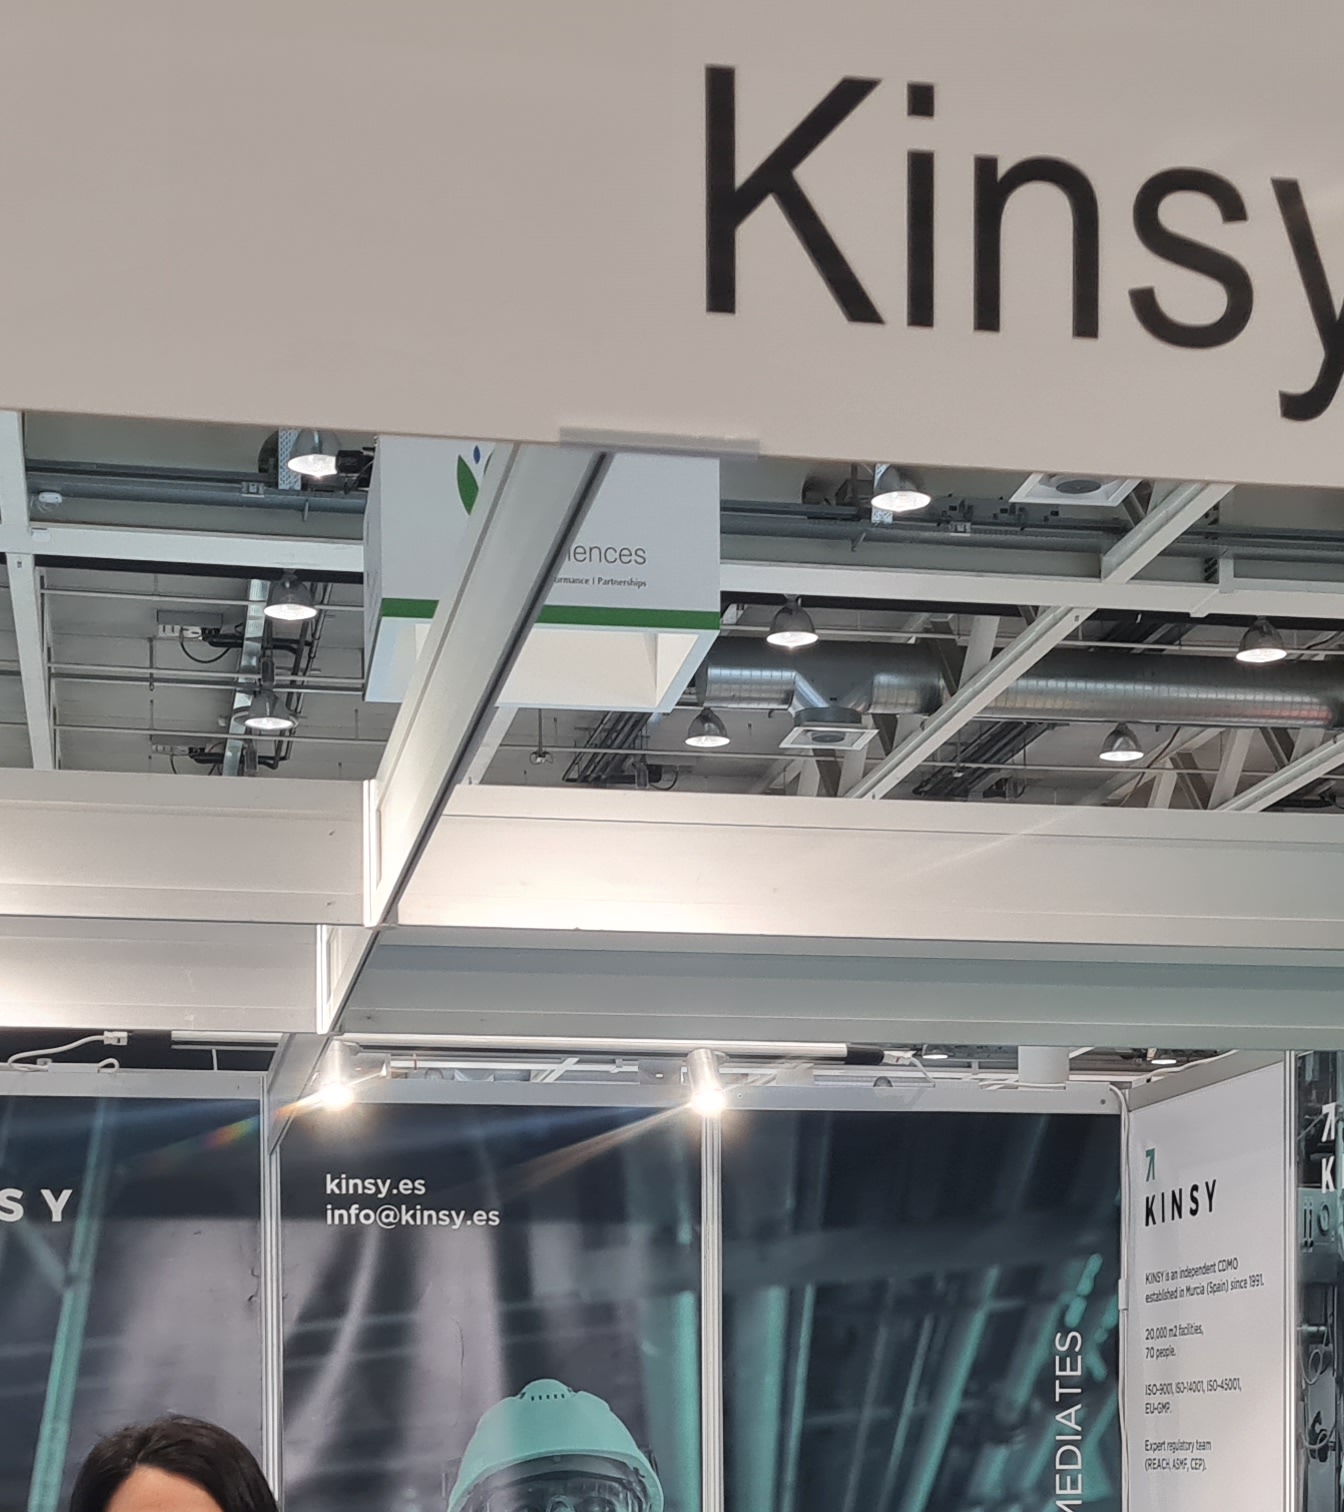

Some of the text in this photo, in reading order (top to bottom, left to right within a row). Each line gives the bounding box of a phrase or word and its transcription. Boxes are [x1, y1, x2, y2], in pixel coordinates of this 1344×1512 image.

[597, 576, 647, 589] Partnerships
[325, 1173, 426, 1198] kinsy.es
[325, 1202, 501, 1228] info@kinsy.es
[1144, 1179, 1218, 1227] KINSY
